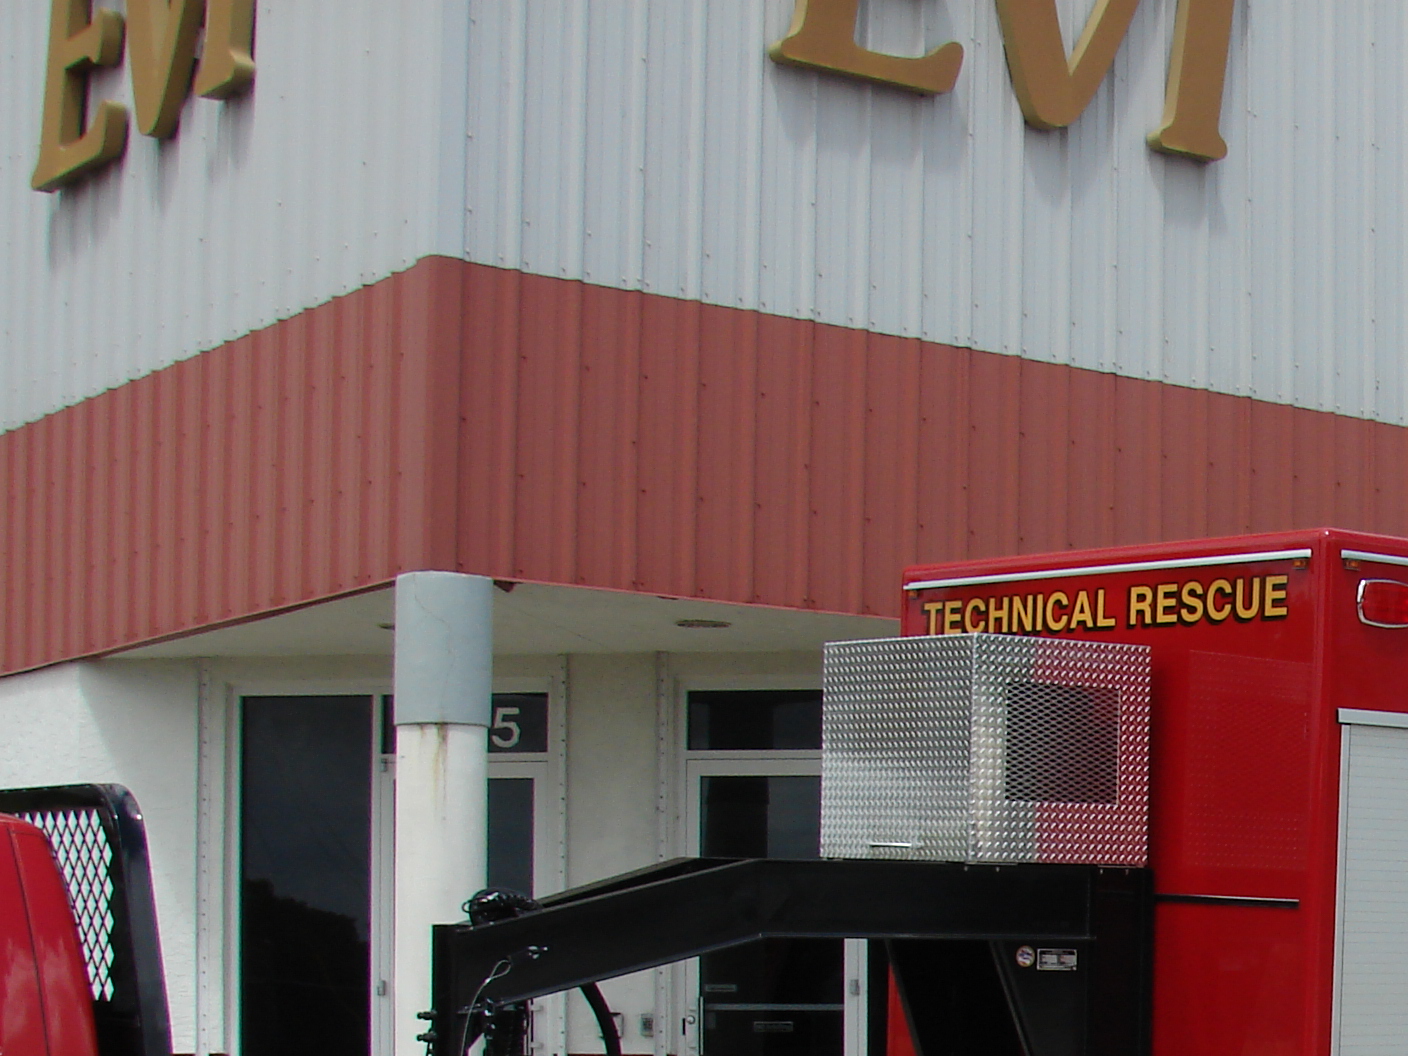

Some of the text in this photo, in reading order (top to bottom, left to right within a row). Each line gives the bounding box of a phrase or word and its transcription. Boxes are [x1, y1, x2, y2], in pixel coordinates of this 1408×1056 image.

[768, 0, 1228, 163] VI
[923, 574, 1289, 636] TECHNICAL RESCUE
[491, 707, 520, 748] 5
